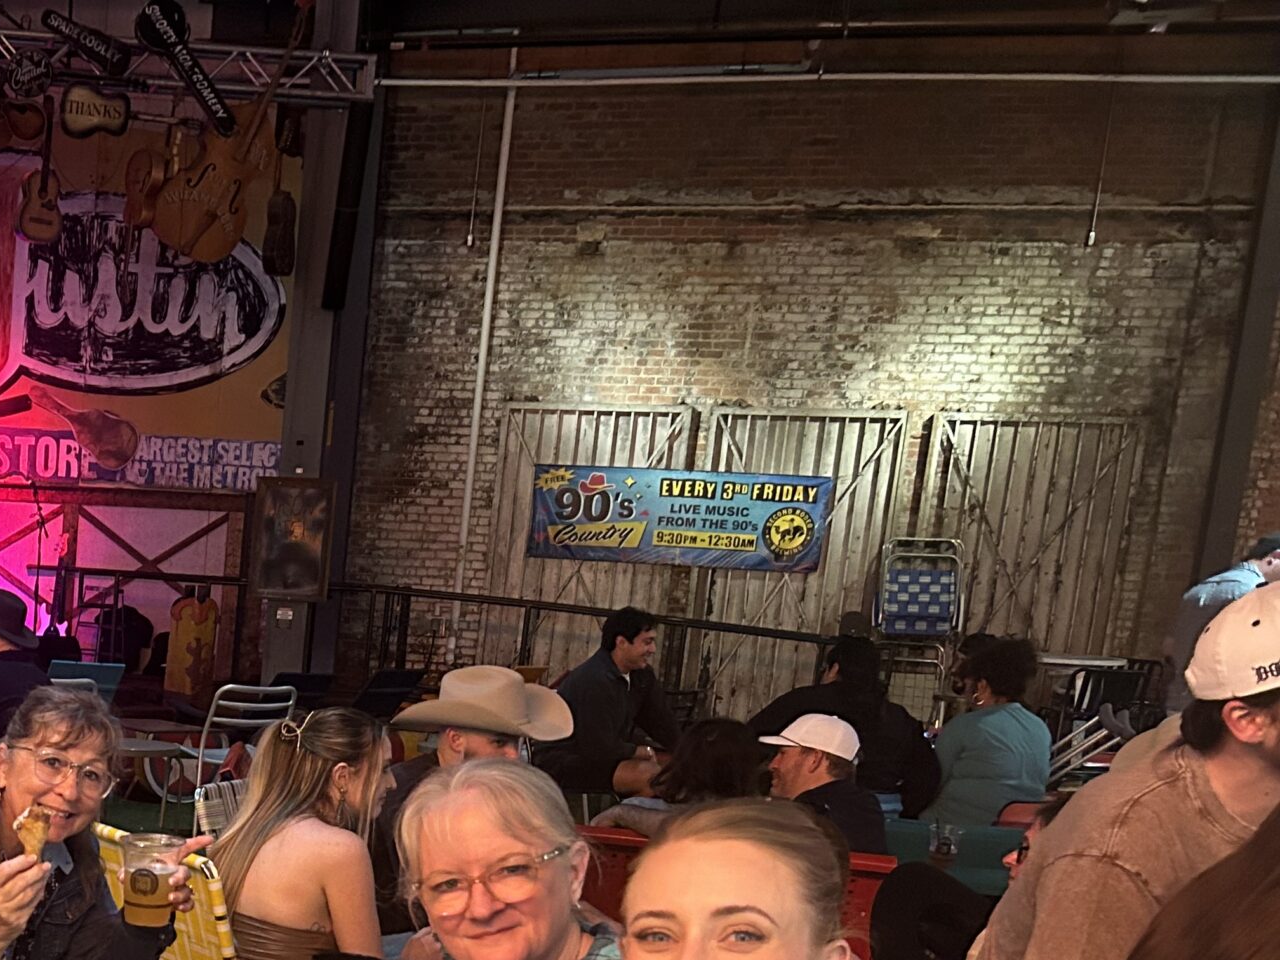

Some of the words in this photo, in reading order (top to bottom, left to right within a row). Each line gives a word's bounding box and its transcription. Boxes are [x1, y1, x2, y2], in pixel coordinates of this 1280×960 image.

[67, 100, 123, 120] THANKS
[134, 435, 215, 466] ARGEST
[660, 479, 717, 499] EVERY
[722, 482, 749, 501] 3RD
[751, 483, 818, 504] FRIDAY
[555, 487, 636, 523] 90's
[670, 503, 701, 515] LIVE
[705, 505, 751, 518] MUSIC
[657, 515, 696, 529] FROM
[700, 517, 729, 530] THE
[731, 519, 760, 532] 90's
[553, 523, 635, 550] Country
[656, 531, 697, 546] 9:30PM
[707, 534, 757, 550] 12:30AM
